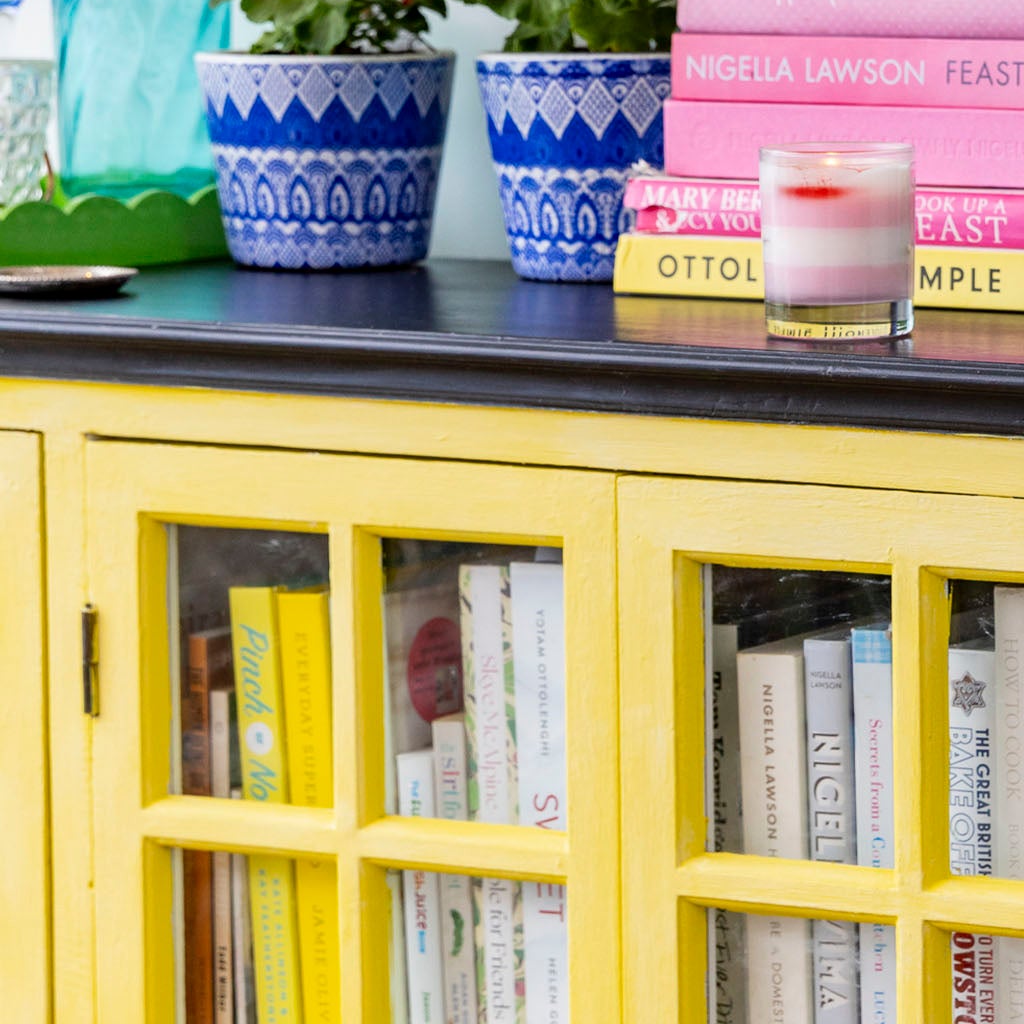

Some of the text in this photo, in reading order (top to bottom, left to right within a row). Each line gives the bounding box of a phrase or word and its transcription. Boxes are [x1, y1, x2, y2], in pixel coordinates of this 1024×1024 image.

[685, 54, 926, 85] NIGELLA LAWSON
[946, 60, 1024, 87] FEAST
[641, 185, 717, 210] MARY
[963, 197, 989, 214] UP
[993, 198, 1008, 215] A
[658, 254, 1001, 293] OTTOL MPLE
[238, 624, 276, 717] Pinch
[535, 609, 550, 756] YOTAM OTTOLENGHI
[810, 671, 842, 680] NIGELLA
[810, 680, 842, 690] LAWSON
[294, 632, 318, 806] EVERYDAY SUPER
[761, 684, 775, 756] NIGELLA
[1004, 638, 1022, 801] HOW TO COOK
[868, 718, 883, 777] Secrets
[975, 728, 990, 758] THE
[765, 765, 778, 840] LAWSON
[870, 781, 884, 820] from
[949, 727, 976, 875] BAKE OFF
[975, 767, 991, 817] GREAT
[871, 823, 882, 833] a
[1007, 823, 1020, 871] BOOK
[311, 905, 326, 965] JAMIE
[490, 909, 508, 936] for
[490, 942, 512, 1020] Friends
[548, 957, 558, 1004] HELEN
[979, 948, 994, 985] TURN
[1008, 959, 1024, 1020] DELIA
